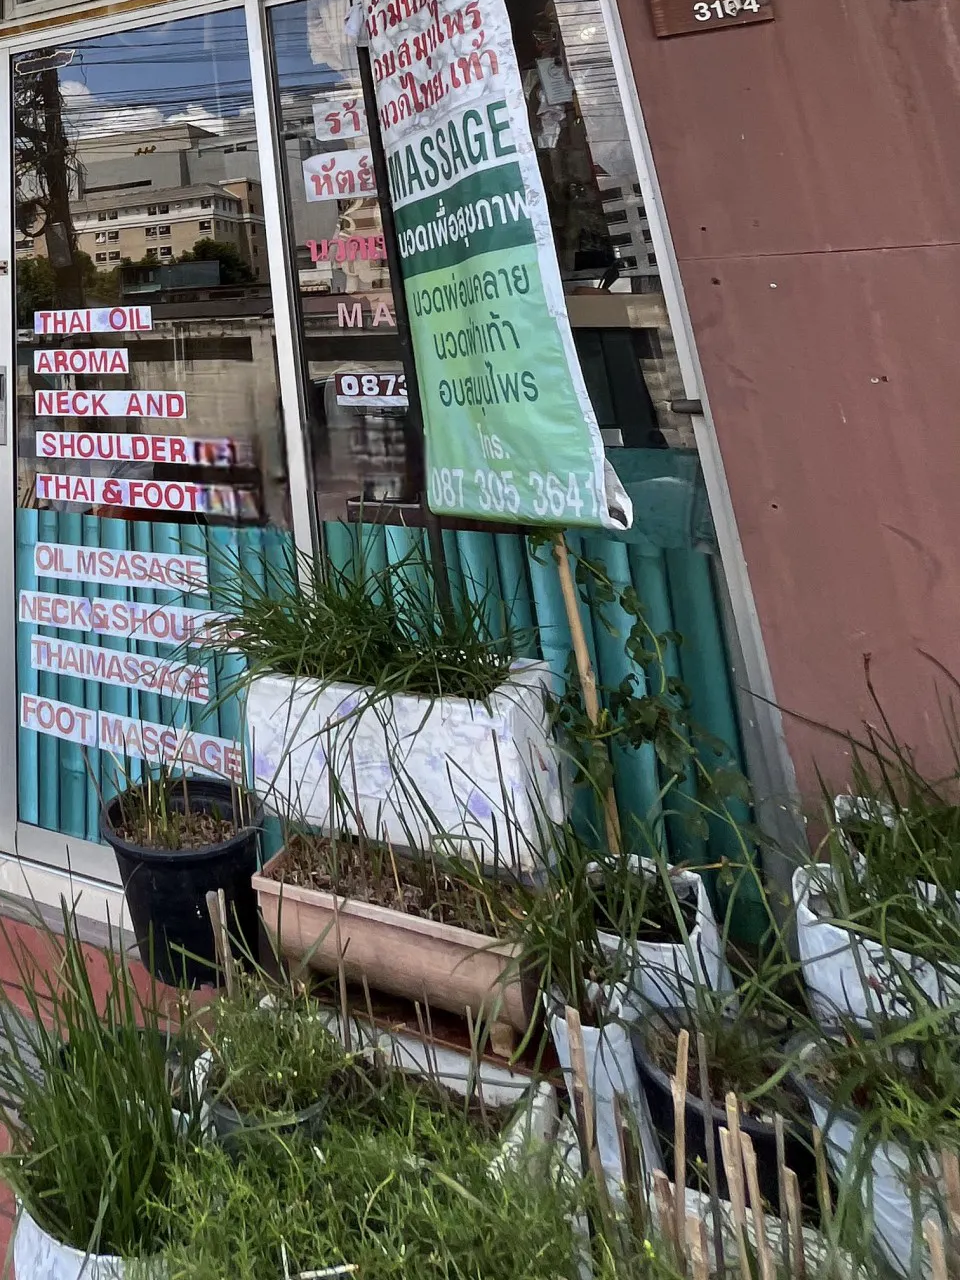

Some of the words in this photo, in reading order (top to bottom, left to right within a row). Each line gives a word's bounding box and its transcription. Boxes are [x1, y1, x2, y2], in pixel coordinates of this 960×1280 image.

[388, 100, 517, 202] MASSAGE
[40, 310, 90, 334] THAI
[109, 307, 150, 331] OIL
[37, 350, 126, 373] AROMA
[38, 391, 109, 416] NECK
[126, 393, 184, 417] AND
[42, 433, 187, 462] SHOULDER
[40, 475, 95, 502] THAI
[129, 481, 199, 512] FOOT
[431, 466, 464, 508] 087
[474, 469, 520, 514] 305
[529, 470, 598, 518] 3641
[36, 545, 73, 573] OIL
[22, 695, 92, 740] FOOT
[101, 715, 242, 780] MASSAGE
